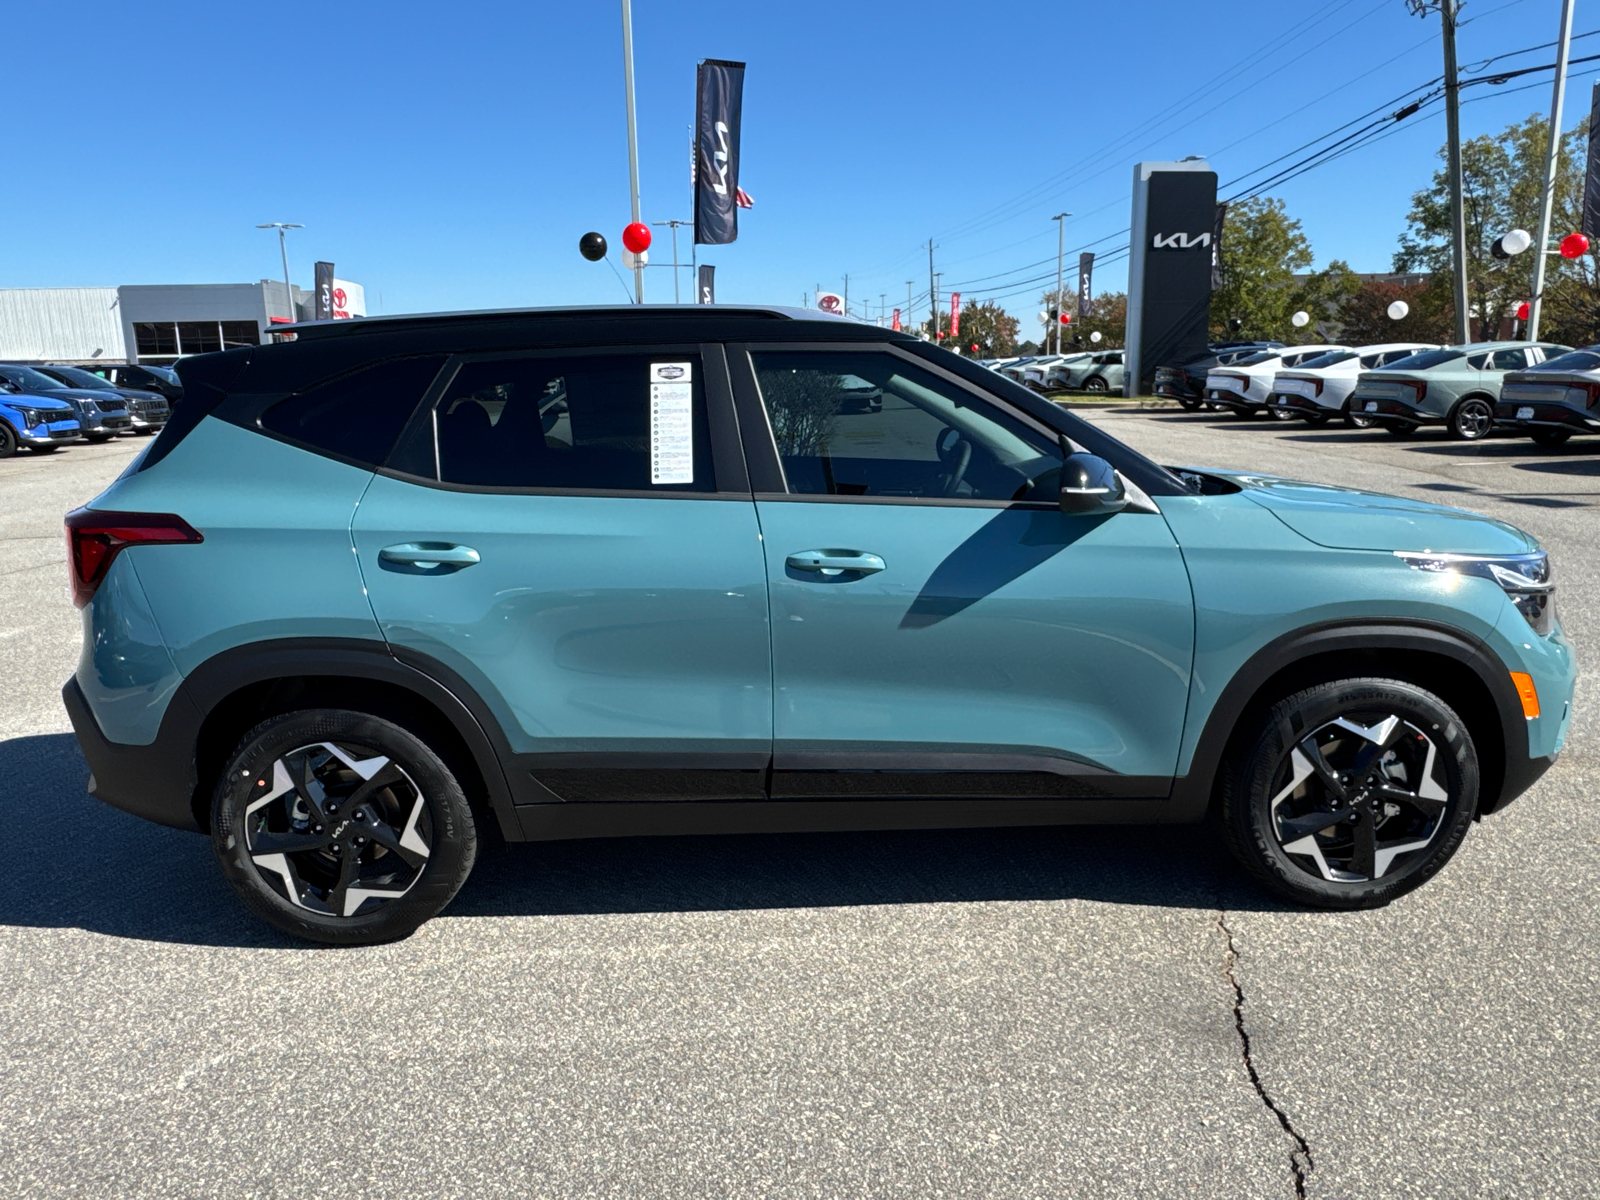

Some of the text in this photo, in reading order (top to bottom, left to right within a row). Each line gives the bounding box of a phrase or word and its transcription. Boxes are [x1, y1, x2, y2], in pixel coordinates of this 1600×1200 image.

[713, 121, 729, 195] KIA
[1153, 232, 1211, 248] KIA
[1349, 790, 1369, 806] KIA
[331, 820, 350, 839] KIA
[1420, 810, 1470, 878] KUMHO
